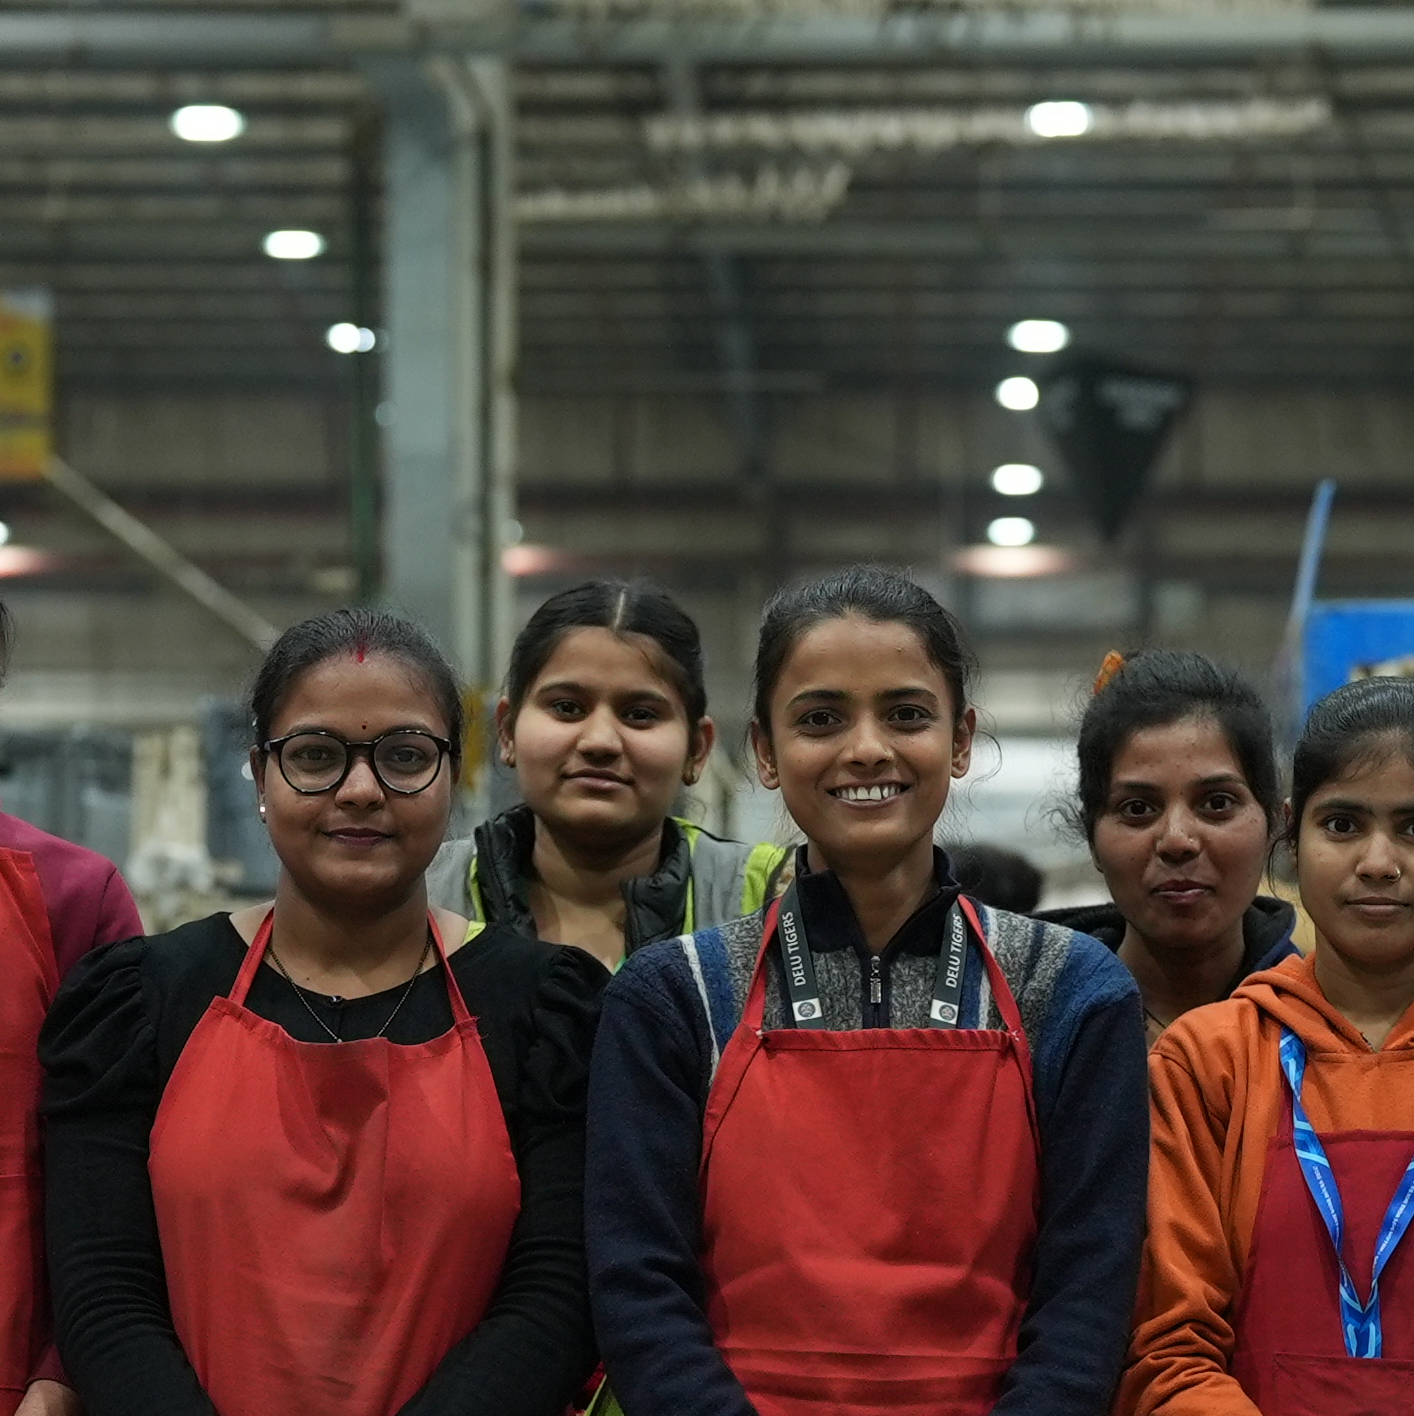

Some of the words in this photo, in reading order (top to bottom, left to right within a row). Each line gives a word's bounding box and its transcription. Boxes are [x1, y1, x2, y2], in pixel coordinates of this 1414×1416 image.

[782, 912, 800, 954] TIGERS
[950, 913, 963, 953] TIGERS
[790, 955, 806, 986] DELU
[946, 955, 960, 988] DELU
